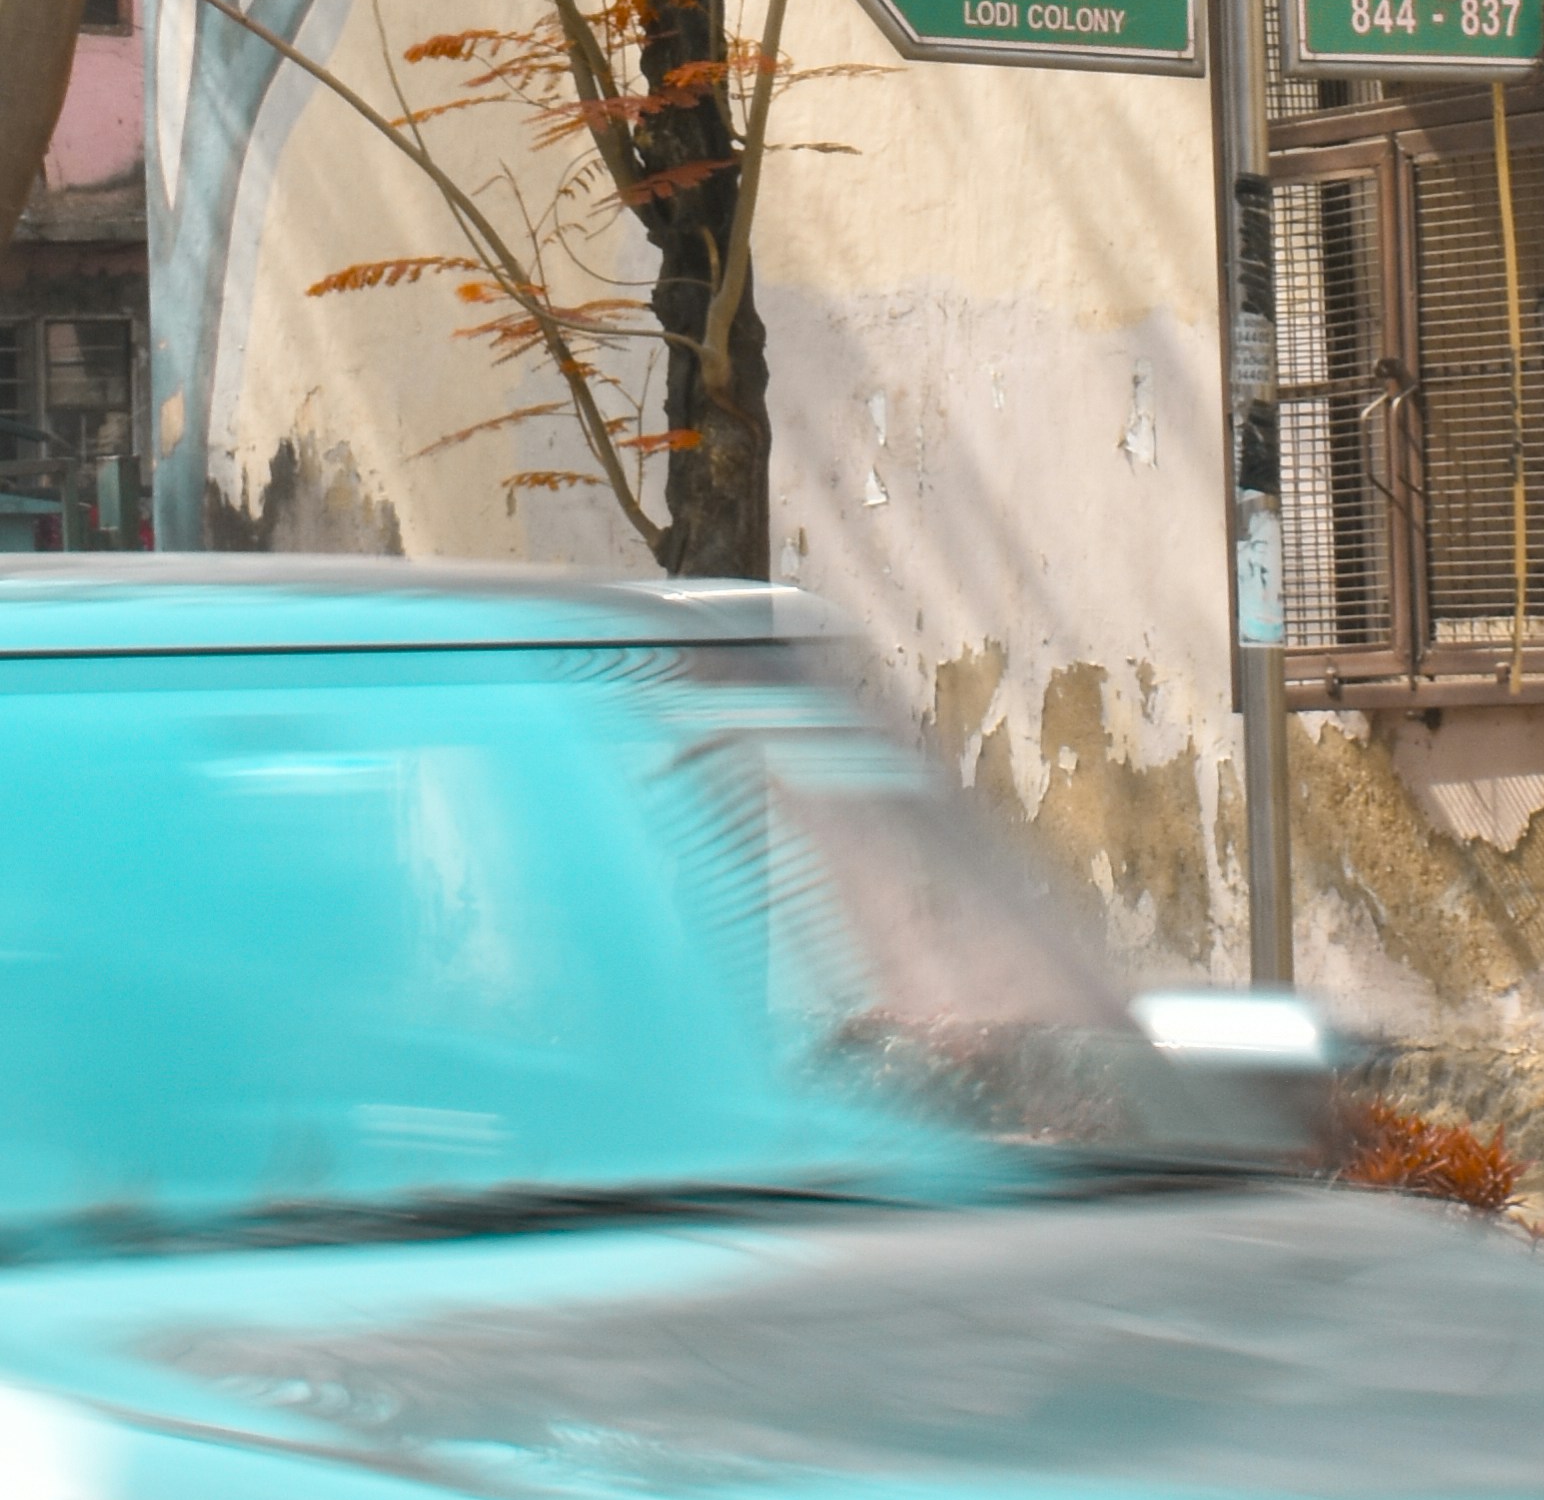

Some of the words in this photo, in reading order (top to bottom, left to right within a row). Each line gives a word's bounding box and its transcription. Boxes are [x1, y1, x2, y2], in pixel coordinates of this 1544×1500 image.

[964, 0, 1018, 27] LODI
[1027, 4, 1125, 33] COLONY
[1432, 13, 1444, 22] -
